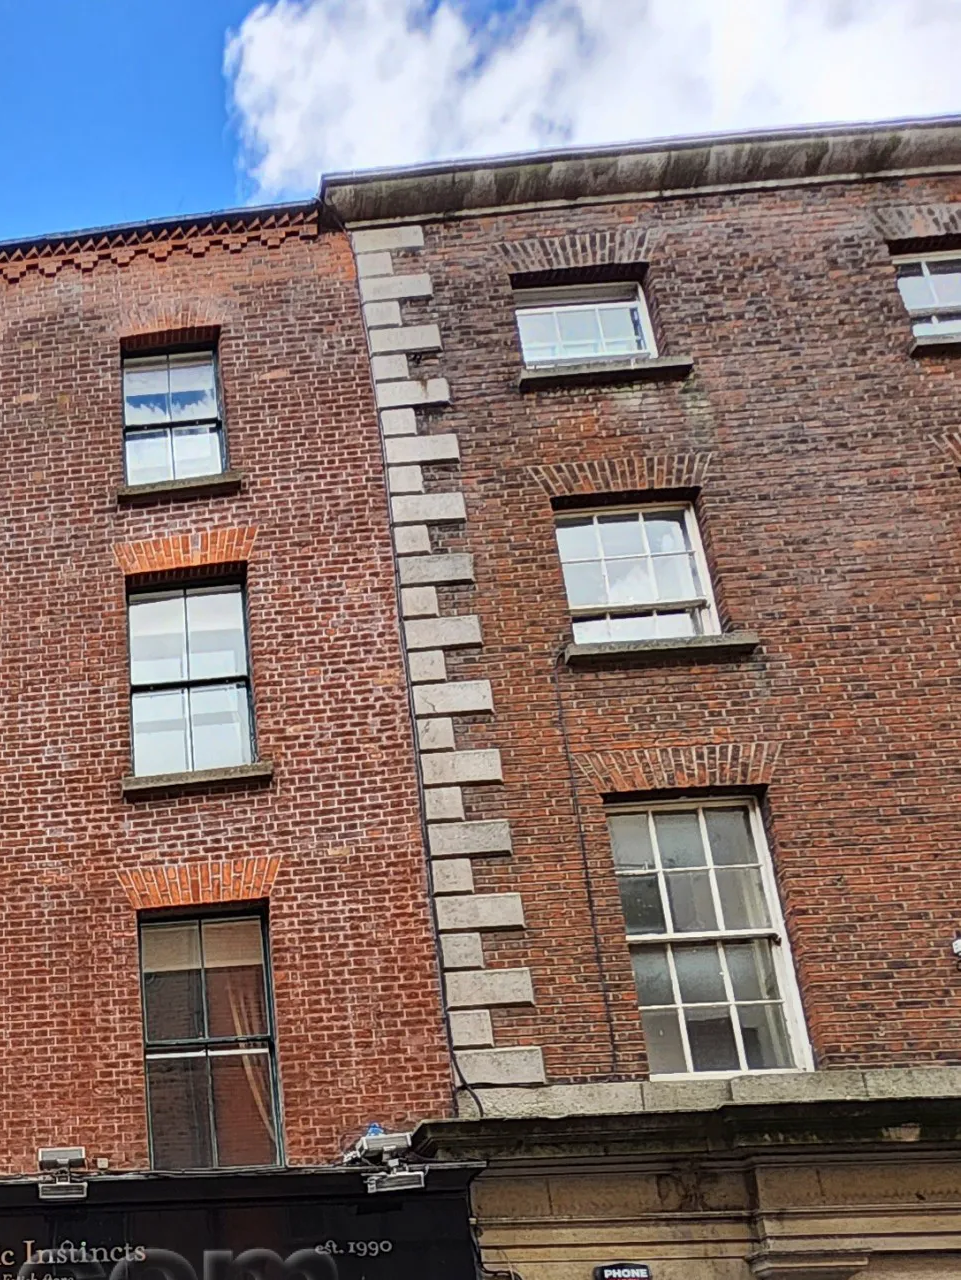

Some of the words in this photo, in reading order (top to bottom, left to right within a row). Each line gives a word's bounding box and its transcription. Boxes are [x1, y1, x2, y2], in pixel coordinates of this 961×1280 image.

[23, 1239, 147, 1265] Instincts
[347, 1240, 393, 1257] 1990
[603, 1268, 649, 1279] PHONE
